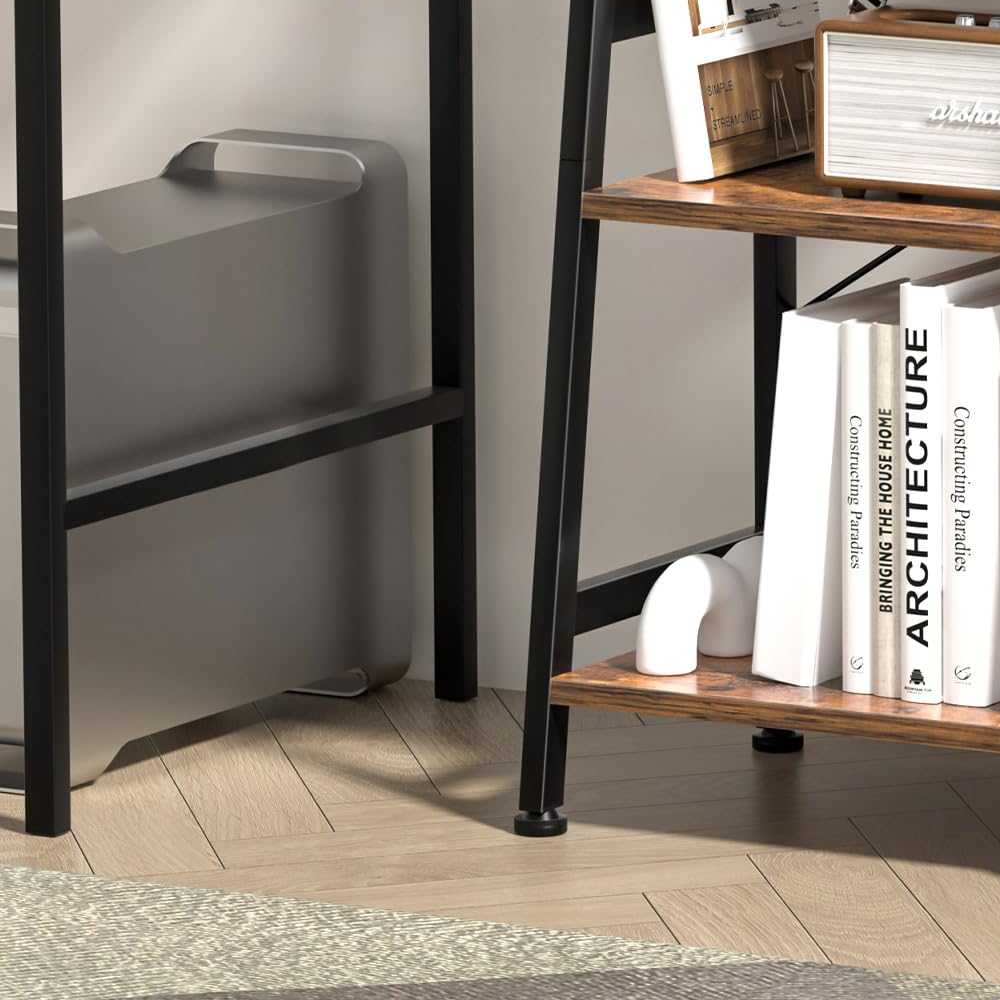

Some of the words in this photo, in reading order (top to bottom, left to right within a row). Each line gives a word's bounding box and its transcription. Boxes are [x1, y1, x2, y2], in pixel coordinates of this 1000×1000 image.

[706, 79, 734, 97] SIMPLE
[712, 108, 762, 131] STREAMLINED
[878, 408, 893, 450] HOME
[950, 406, 971, 504] Constructing
[848, 415, 863, 506] Constructing
[878, 454, 893, 504] HOUSE
[905, 327, 929, 648] ARCHITECTURE
[850, 510, 864, 570] Paradies
[879, 508, 893, 536] THE
[955, 509, 971, 573] Paradies
[879, 541, 893, 613] BRINGING
